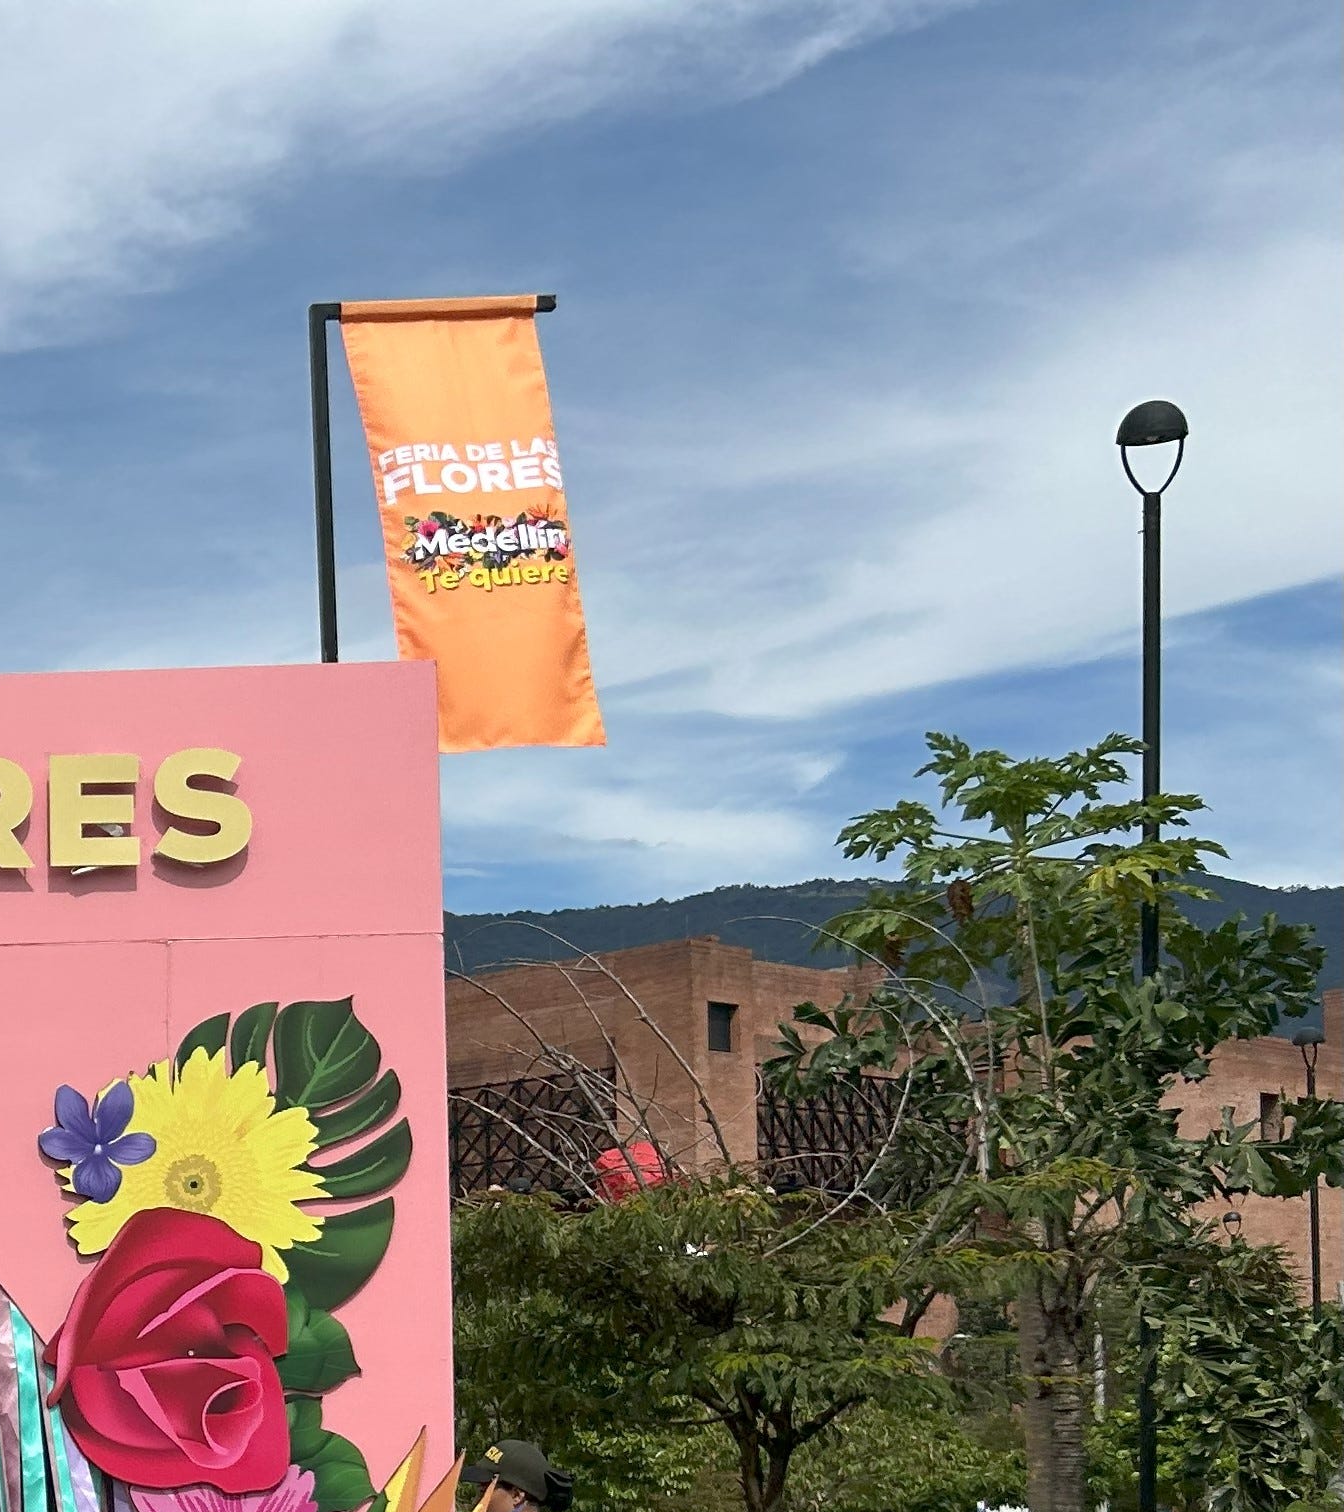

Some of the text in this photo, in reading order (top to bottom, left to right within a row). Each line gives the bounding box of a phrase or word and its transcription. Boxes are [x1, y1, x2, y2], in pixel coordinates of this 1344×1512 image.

[378, 438, 558, 471] FERIA DE LAS
[382, 457, 563, 506] FLORES
[414, 521, 566, 560] Medellín
[420, 561, 569, 593] Te quiere
